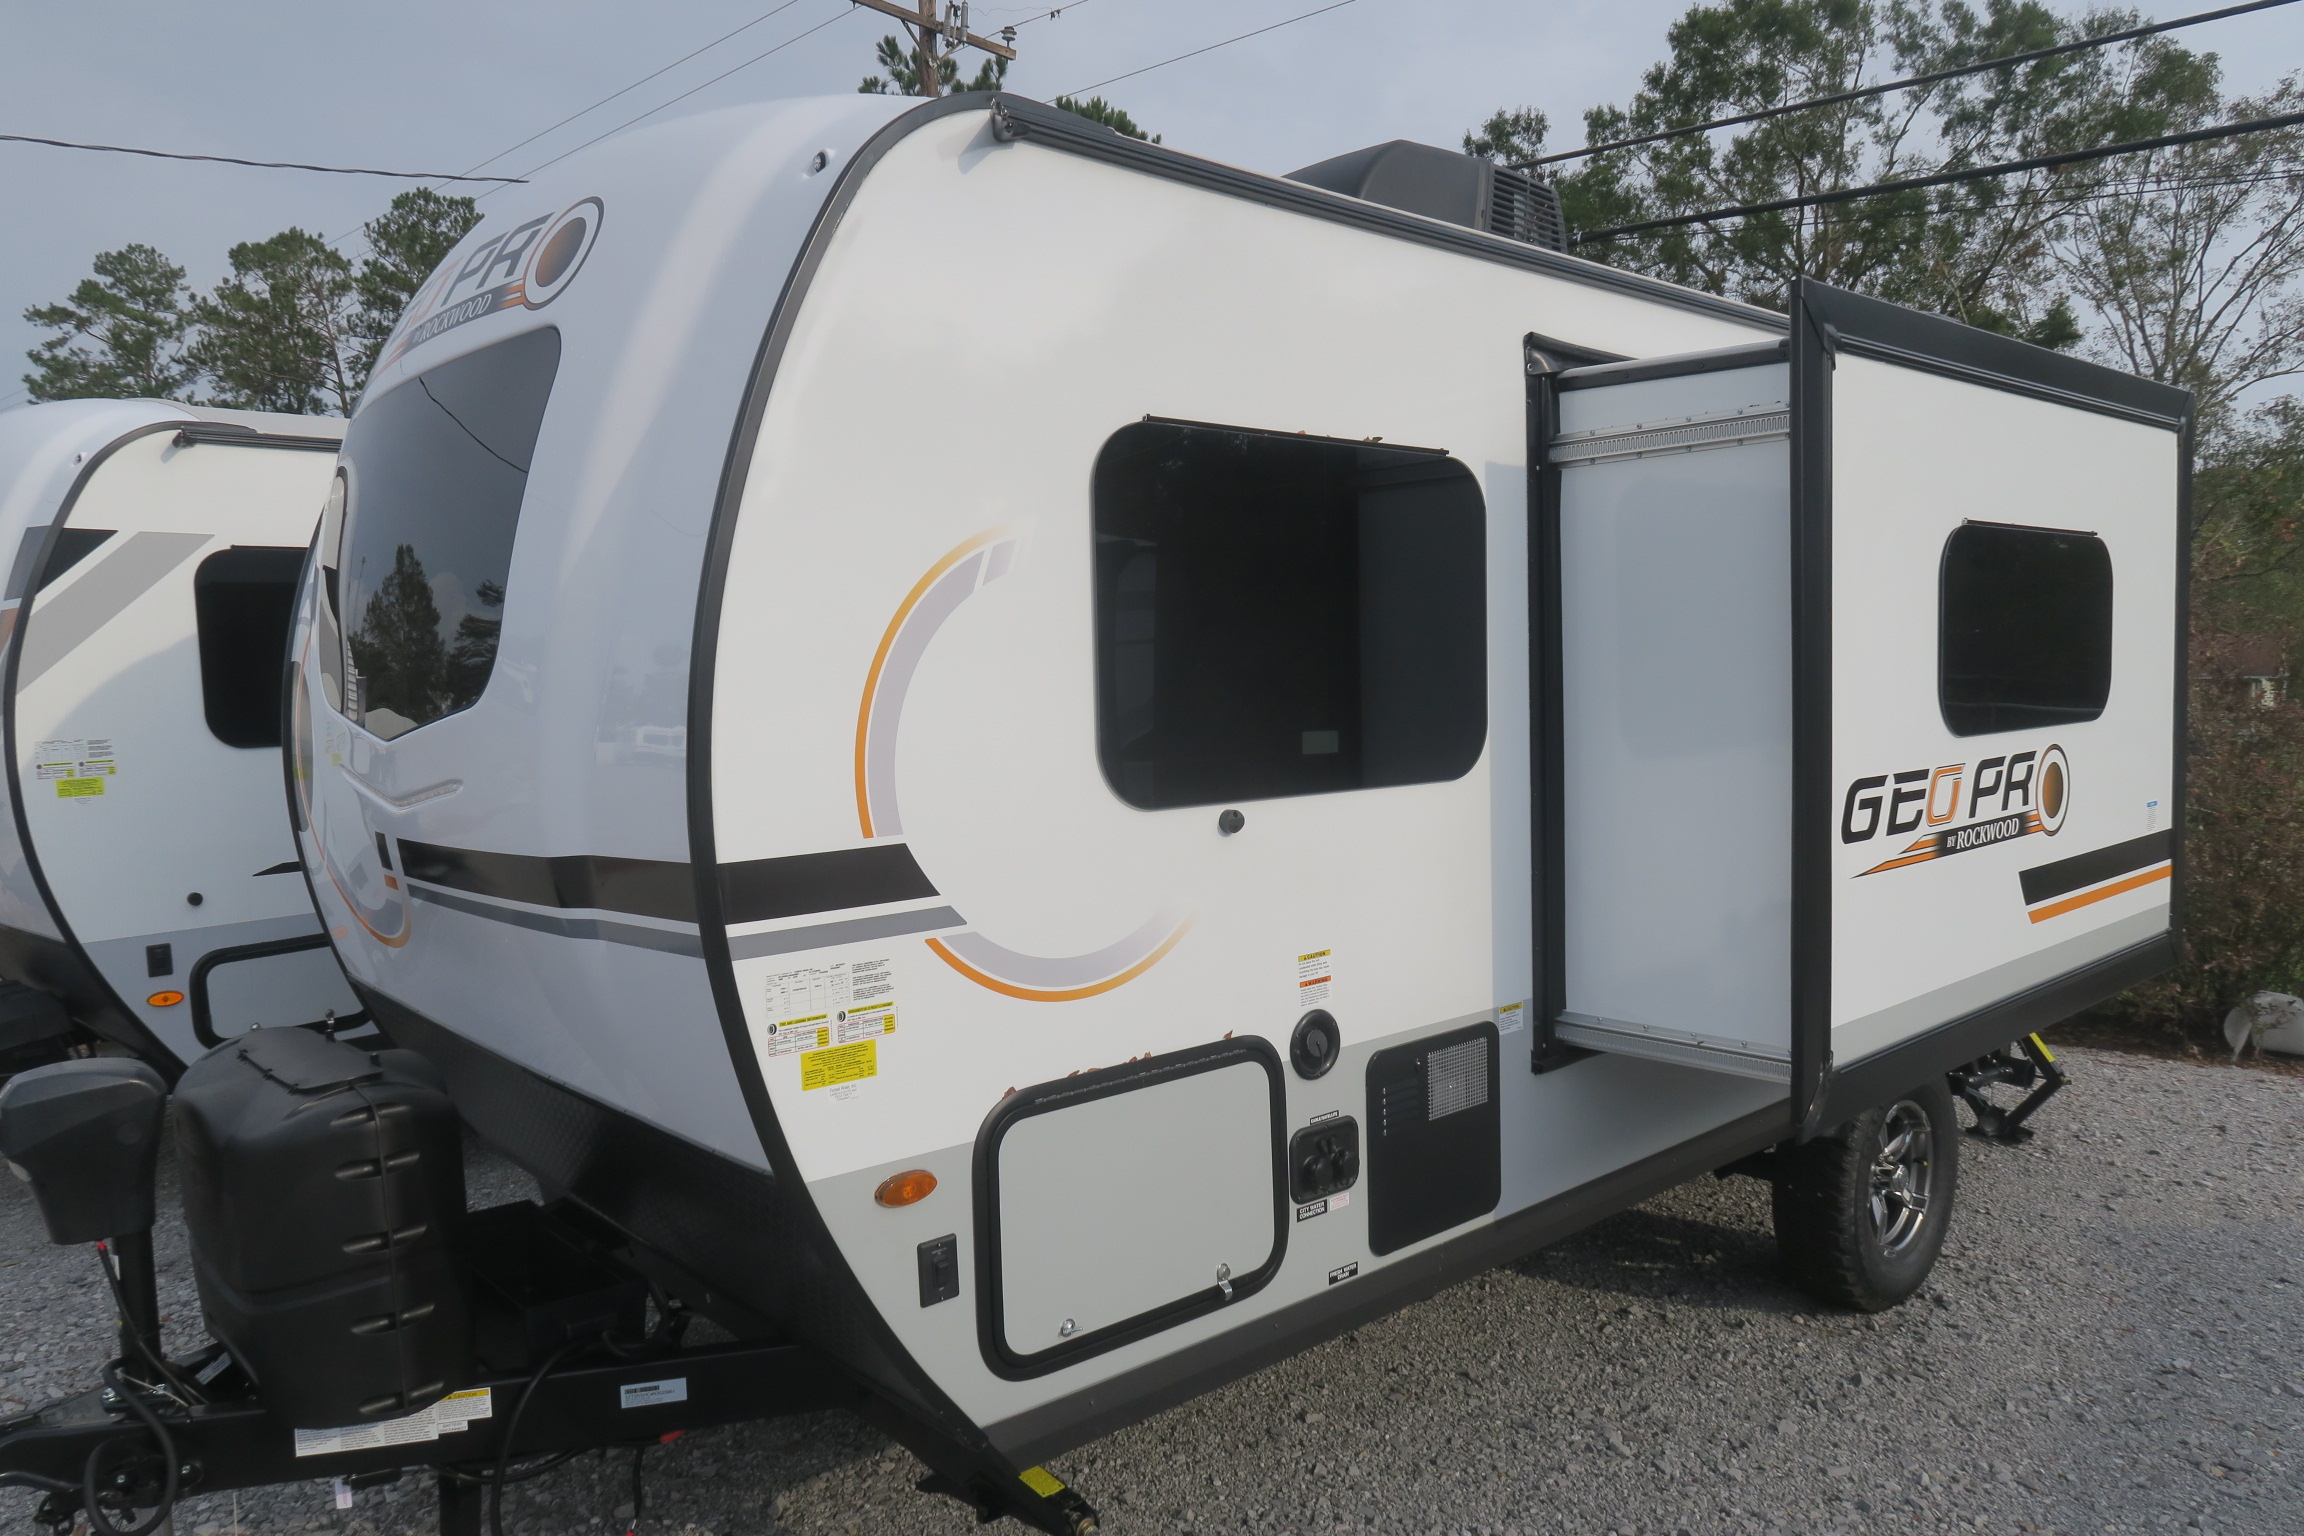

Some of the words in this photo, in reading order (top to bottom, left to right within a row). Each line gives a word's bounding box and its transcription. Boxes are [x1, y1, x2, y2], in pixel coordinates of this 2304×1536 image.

[419, 293, 492, 343] ROCKWOOD
[1841, 763, 1965, 844] GEO
[1969, 744, 2070, 837] PRO
[1947, 835, 1956, 848] BY
[1957, 818, 2019, 849] ROCKWOOD
[1307, 951, 1326, 960] CAUTION
[1308, 976, 1328, 986] WARNING
[1299, 1206, 1310, 1214] CITY
[1310, 1202, 1325, 1211] WATER
[1299, 1207, 1325, 1220] CONNECTION
[1329, 1268, 1343, 1278] FRESH
[1343, 1263, 1357, 1272] WATER
[1337, 1271, 1350, 1280] DRAIN
